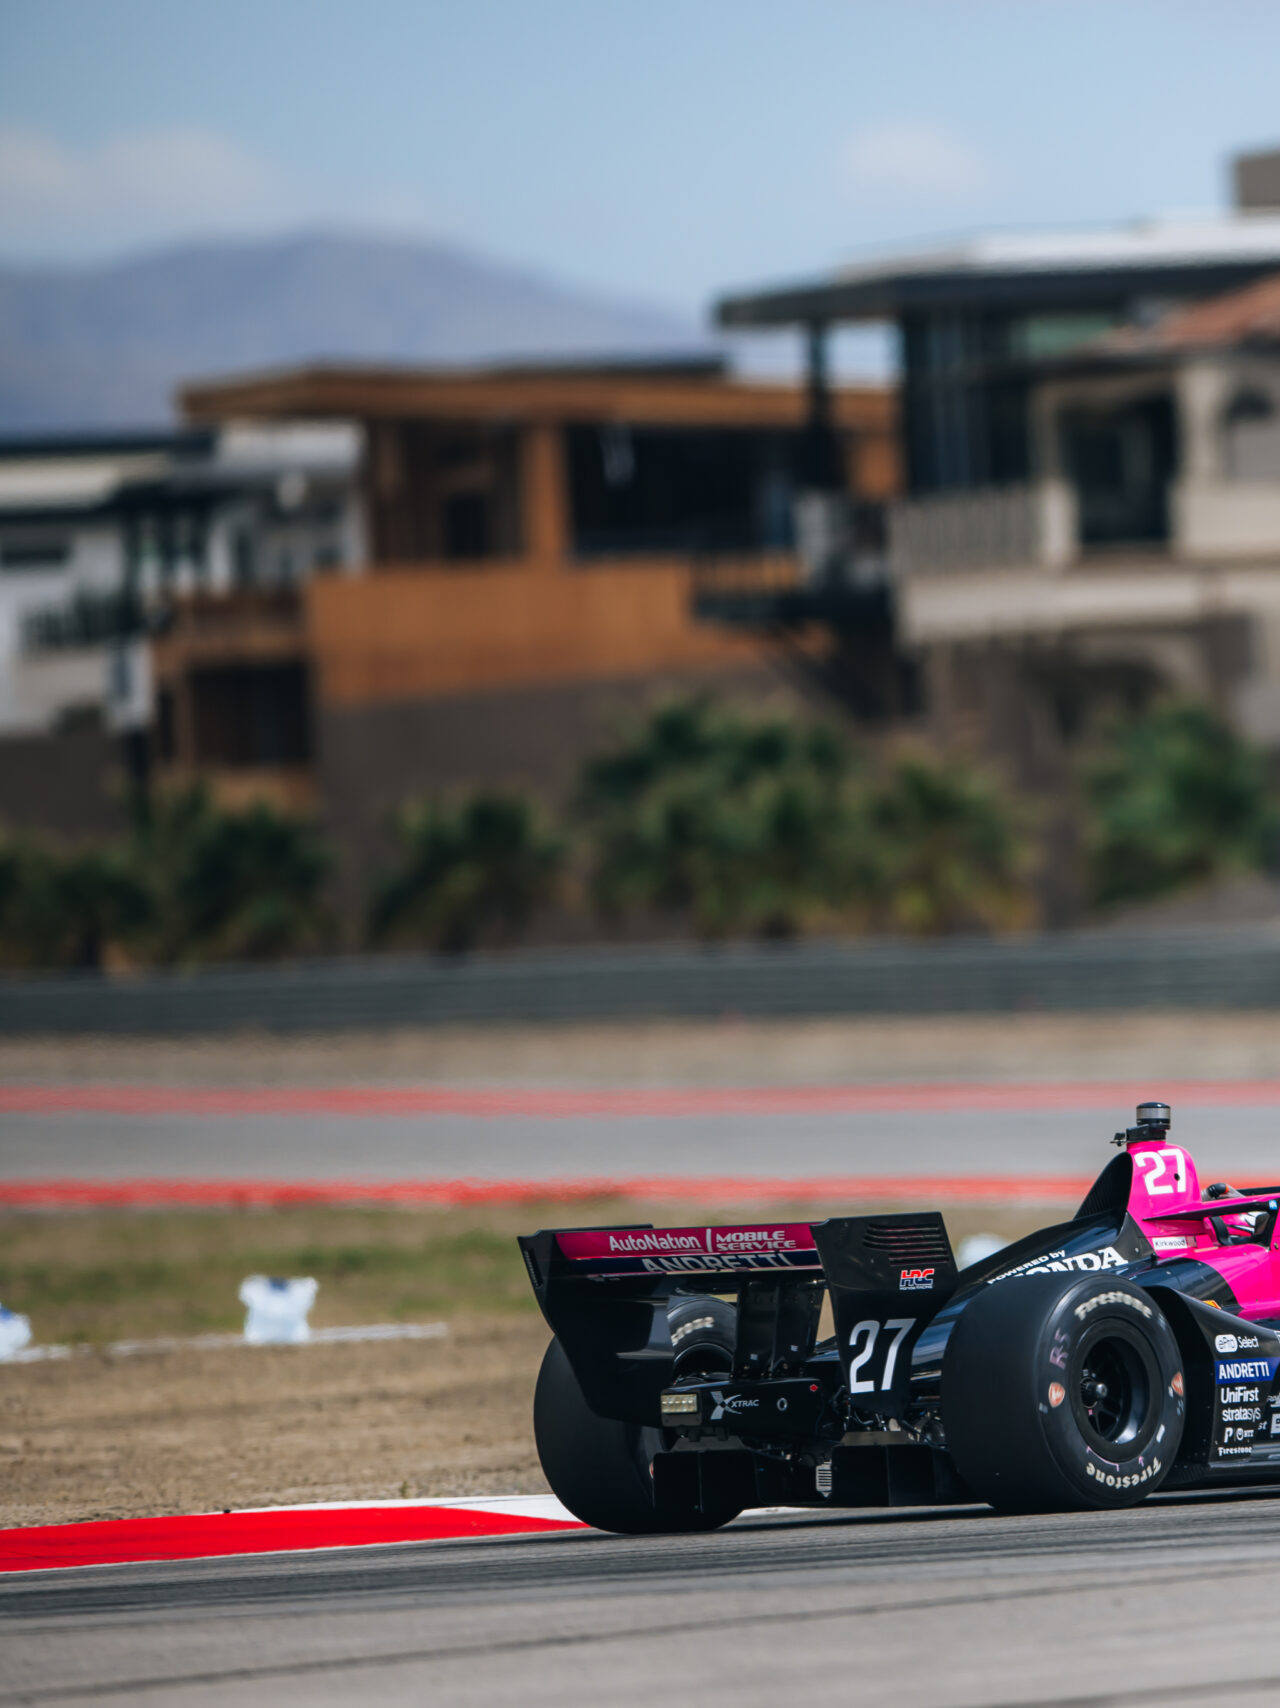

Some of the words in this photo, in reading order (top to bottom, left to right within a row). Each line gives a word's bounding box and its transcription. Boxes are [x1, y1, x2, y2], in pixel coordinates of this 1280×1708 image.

[1134, 1148, 1186, 1195] 27
[609, 1233, 702, 1252] AutoNation
[715, 1230, 785, 1243] MOBILE
[1155, 1238, 1186, 1247] Kirkwood
[715, 1240, 797, 1252] SERVICE
[987, 1255, 1049, 1285] POWERED
[1049, 1250, 1066, 1261] by
[849, 1318, 917, 1394] 27
[1219, 1361, 1270, 1380] ANDRETTI
[731, 1399, 760, 1408] XTRAC
[1221, 1386, 1259, 1404] UniFirst
[1222, 1406, 1261, 1423] stratasys
[1218, 1446, 1252, 1456] Firestone
[1086, 1456, 1162, 1489] Firestone
